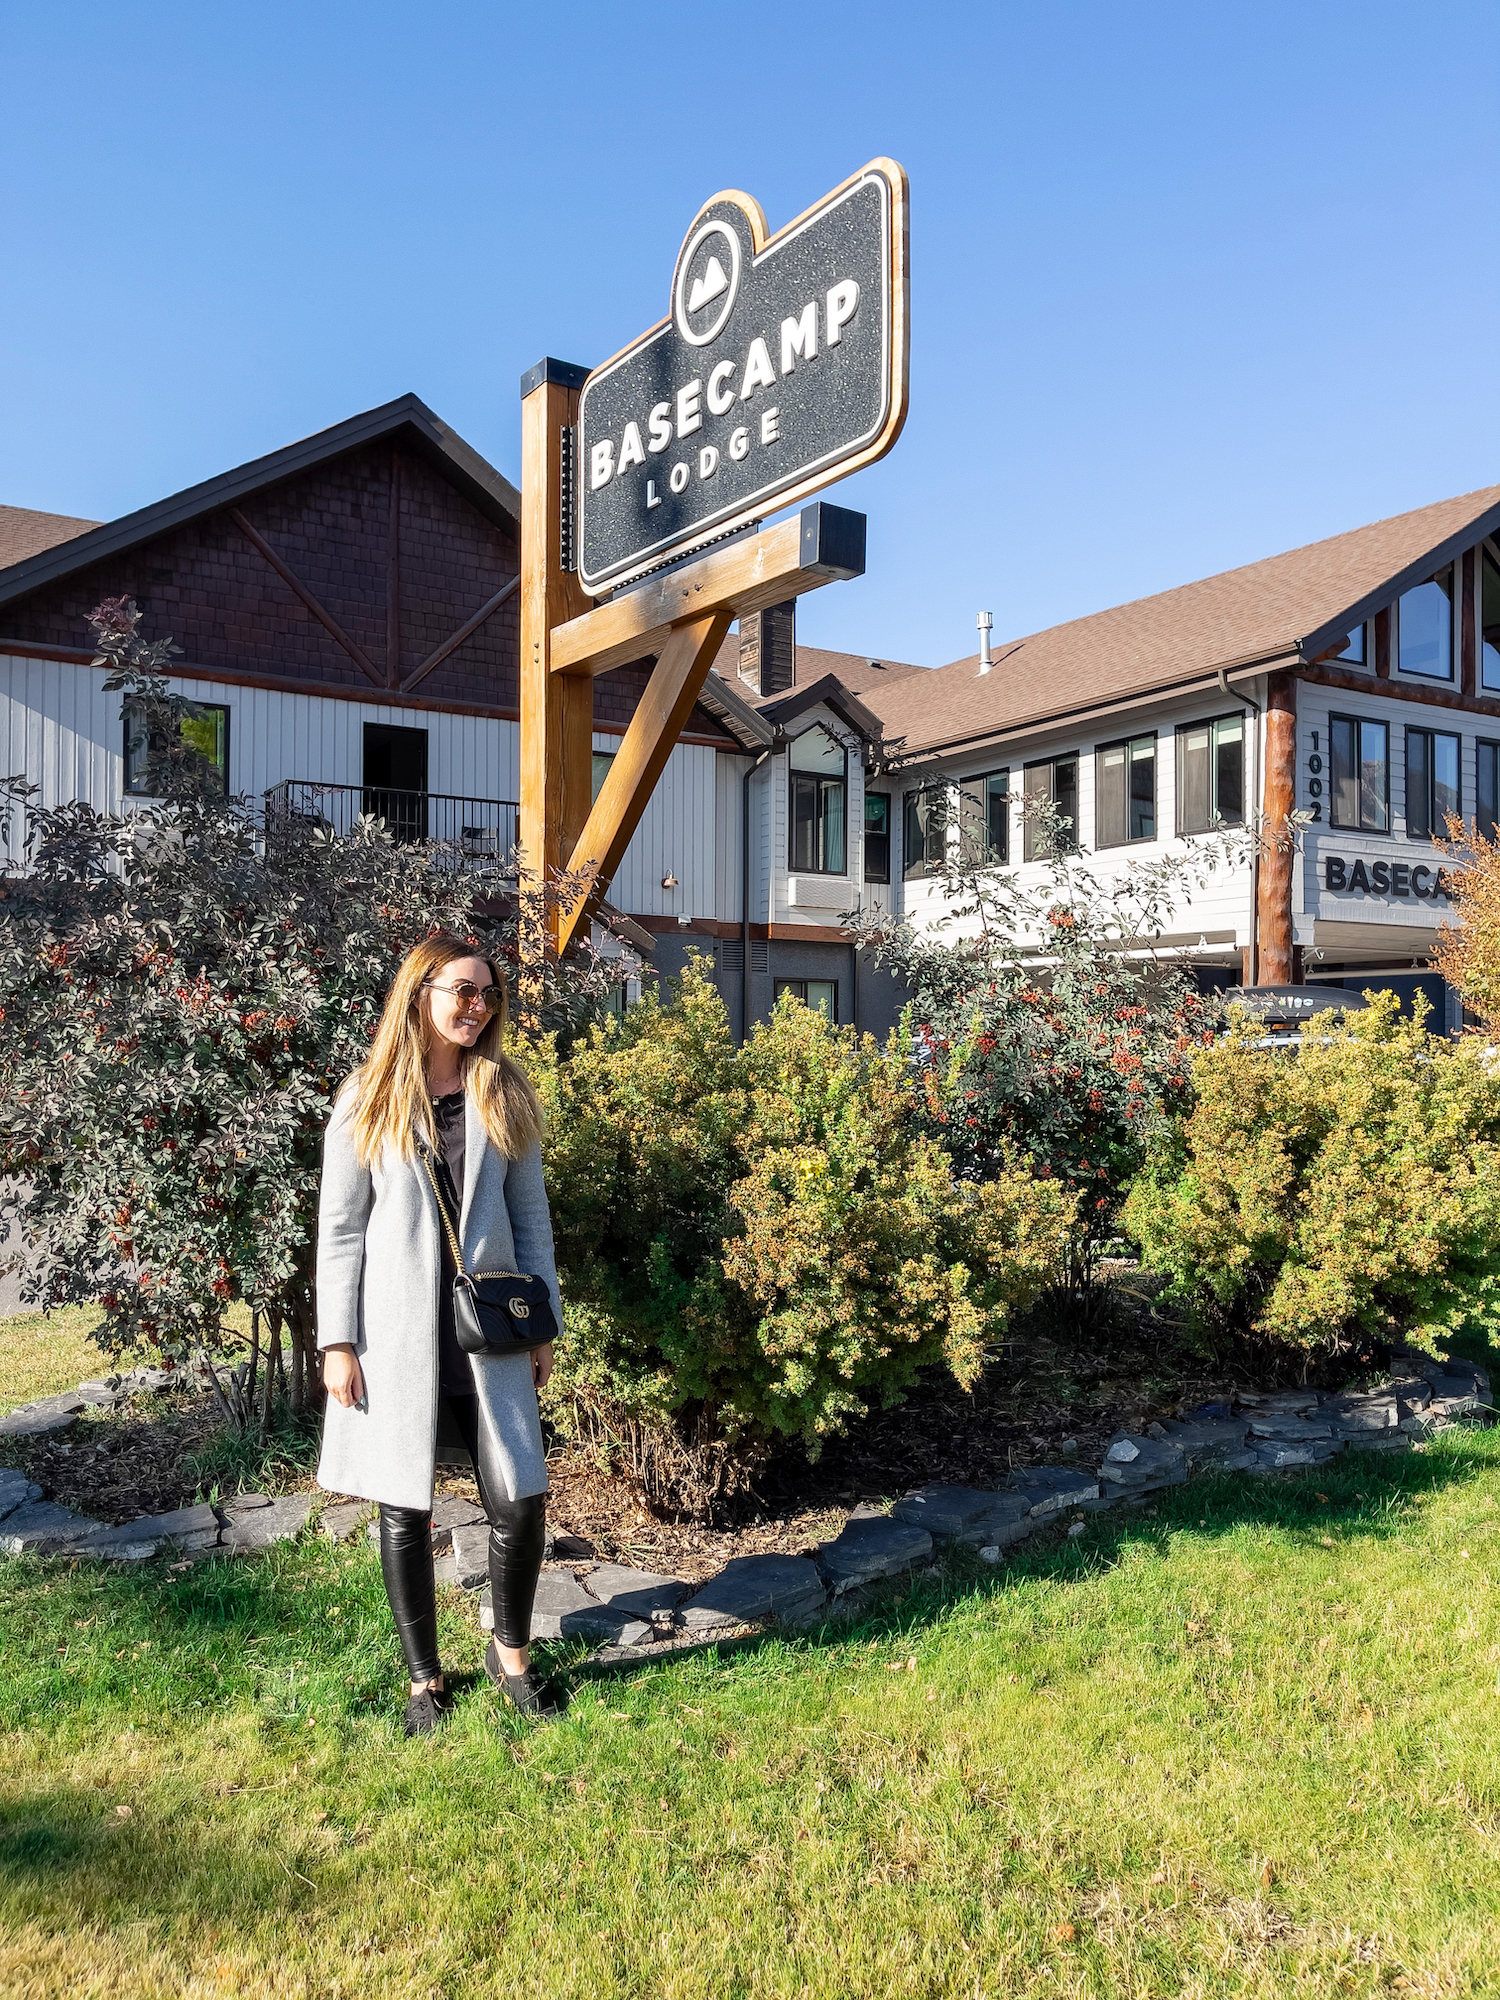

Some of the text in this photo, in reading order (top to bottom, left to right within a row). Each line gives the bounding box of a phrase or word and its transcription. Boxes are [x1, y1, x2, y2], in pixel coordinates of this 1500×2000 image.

[590, 279, 860, 491] BASECAMP
[646, 407, 780, 509] LODGE
[1309, 731, 1322, 821] 1002
